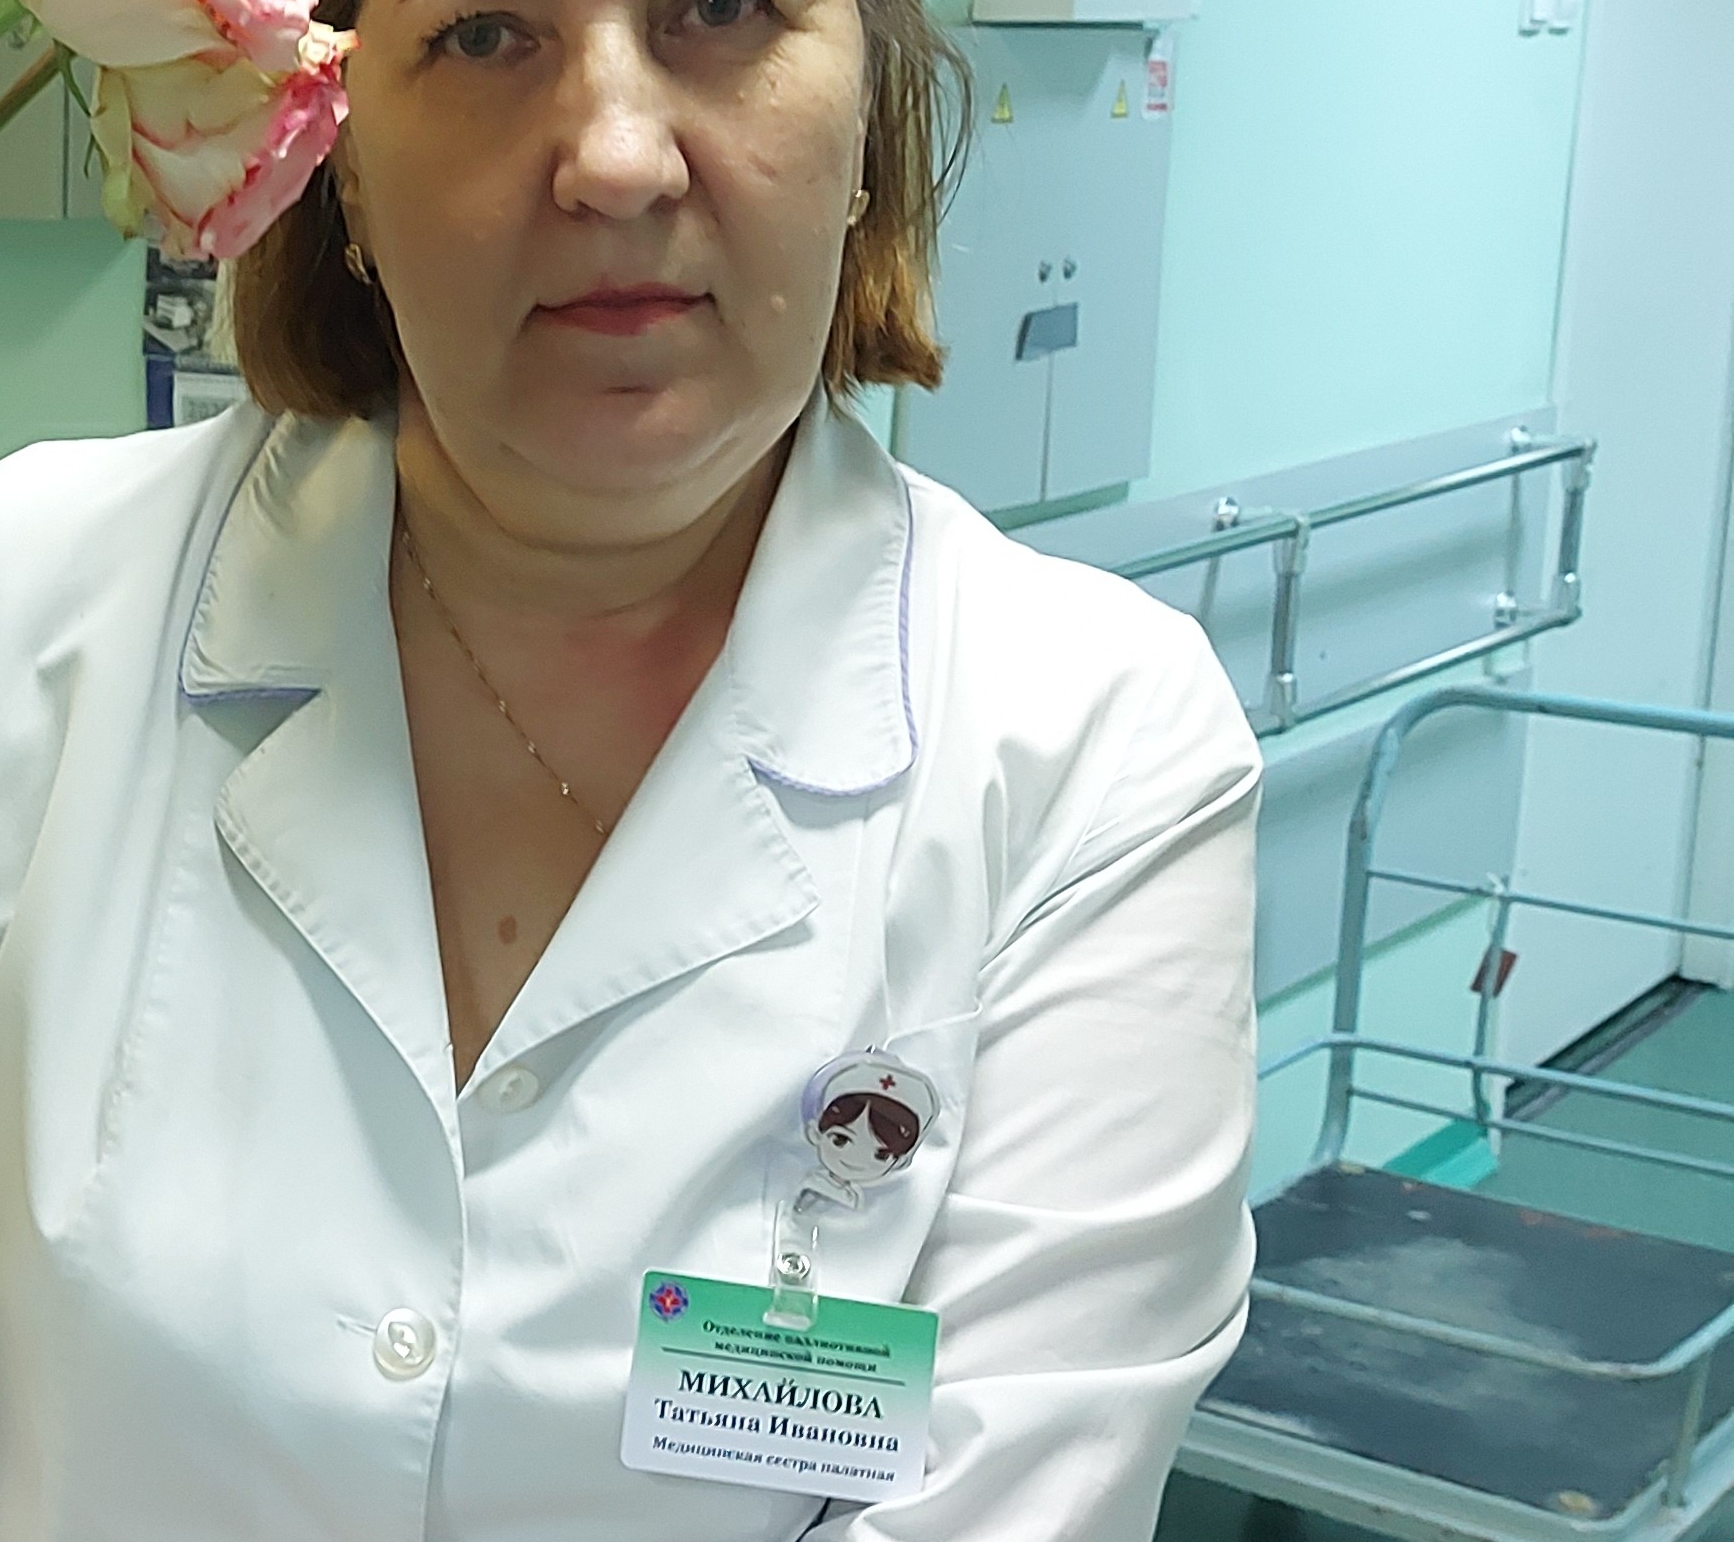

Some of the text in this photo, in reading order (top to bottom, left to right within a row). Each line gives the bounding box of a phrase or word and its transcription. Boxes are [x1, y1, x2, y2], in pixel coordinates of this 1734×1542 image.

[702, 1318, 783, 1344] Отделение
[714, 1340, 877, 1373] медицинской помощи
[678, 1369, 883, 1419] МИХАЙЛОВА
[654, 1397, 899, 1452] Татьяна Ивановна
[652, 1435, 896, 1483] Медицинская сестра палатная
